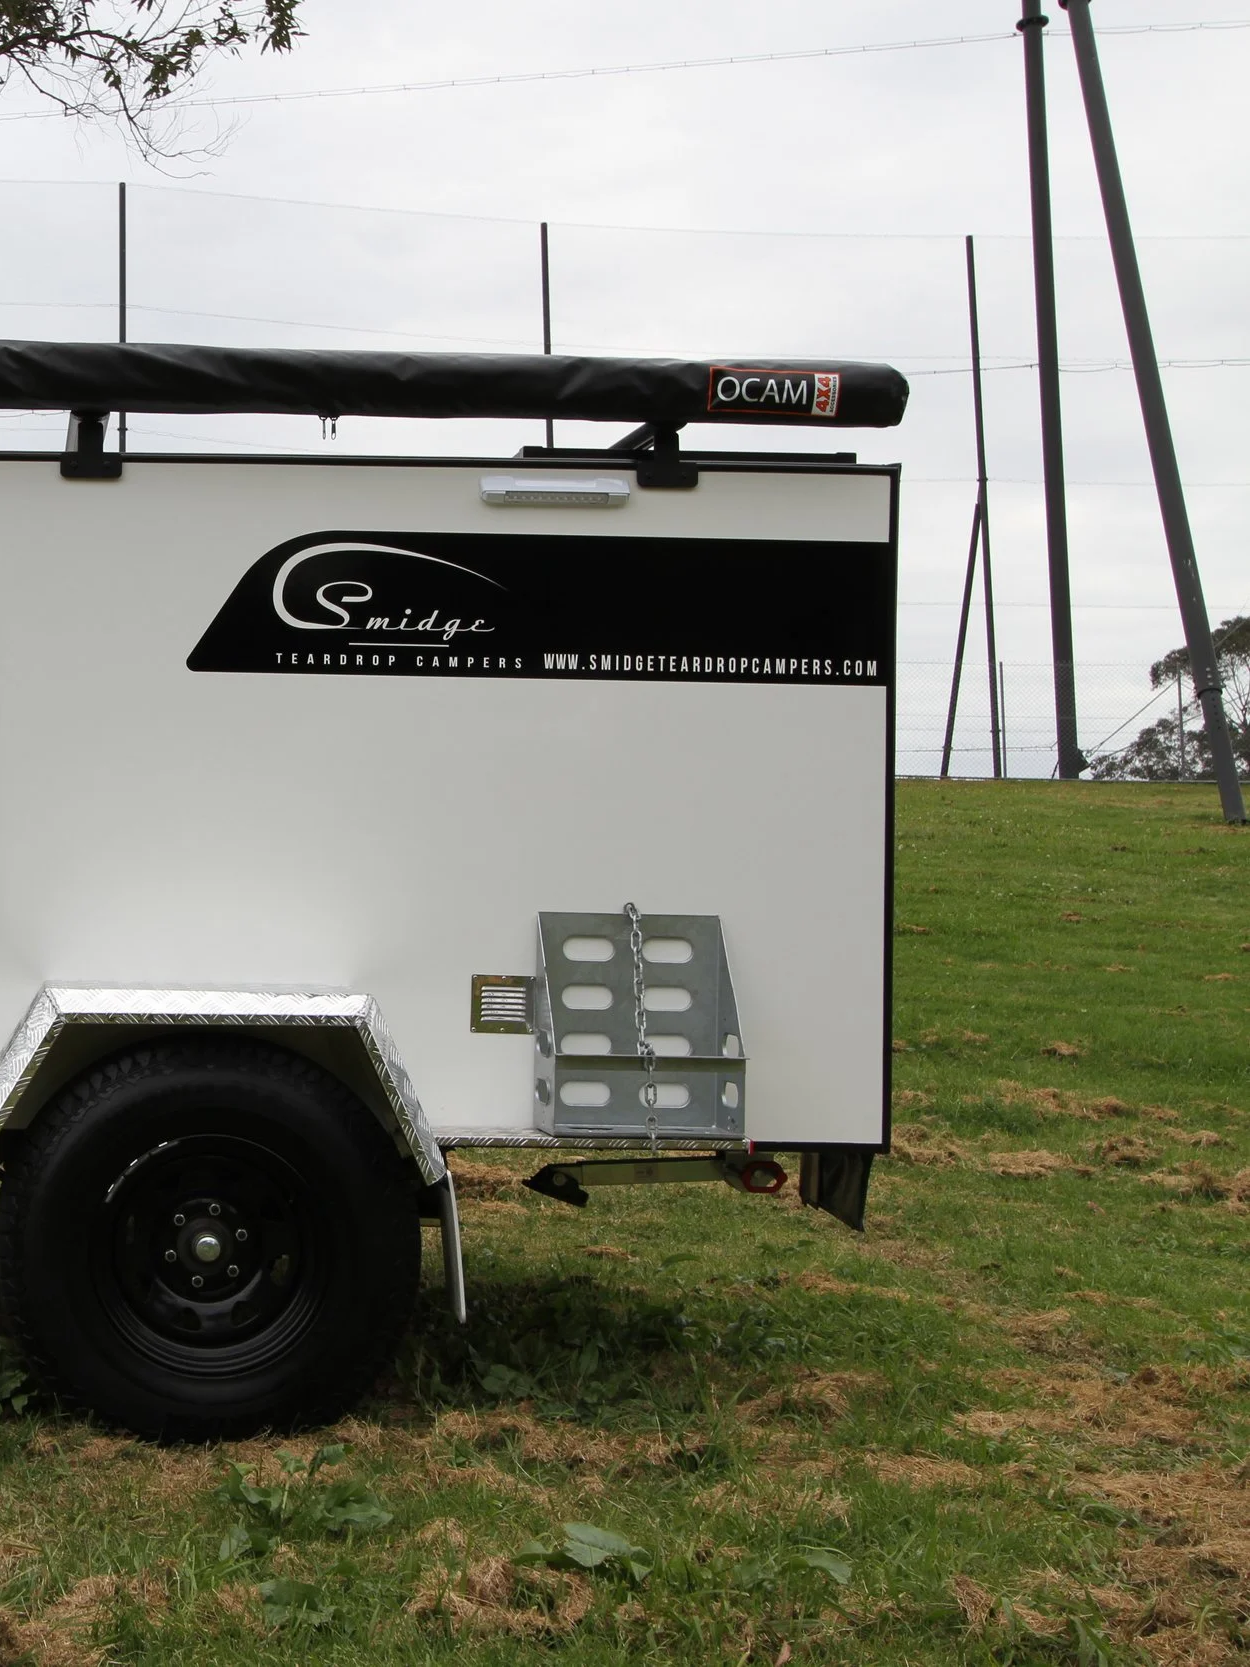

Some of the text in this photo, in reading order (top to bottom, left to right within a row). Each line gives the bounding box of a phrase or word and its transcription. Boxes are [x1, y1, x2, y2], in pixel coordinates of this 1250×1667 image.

[717, 376, 807, 405] OCAM
[273, 580, 495, 641] Smidge
[276, 652, 522, 669] TEARDROP CAMPERS
[543, 653, 877, 677] WWW.SMIDGETEARDROPCAMPERS.COM
